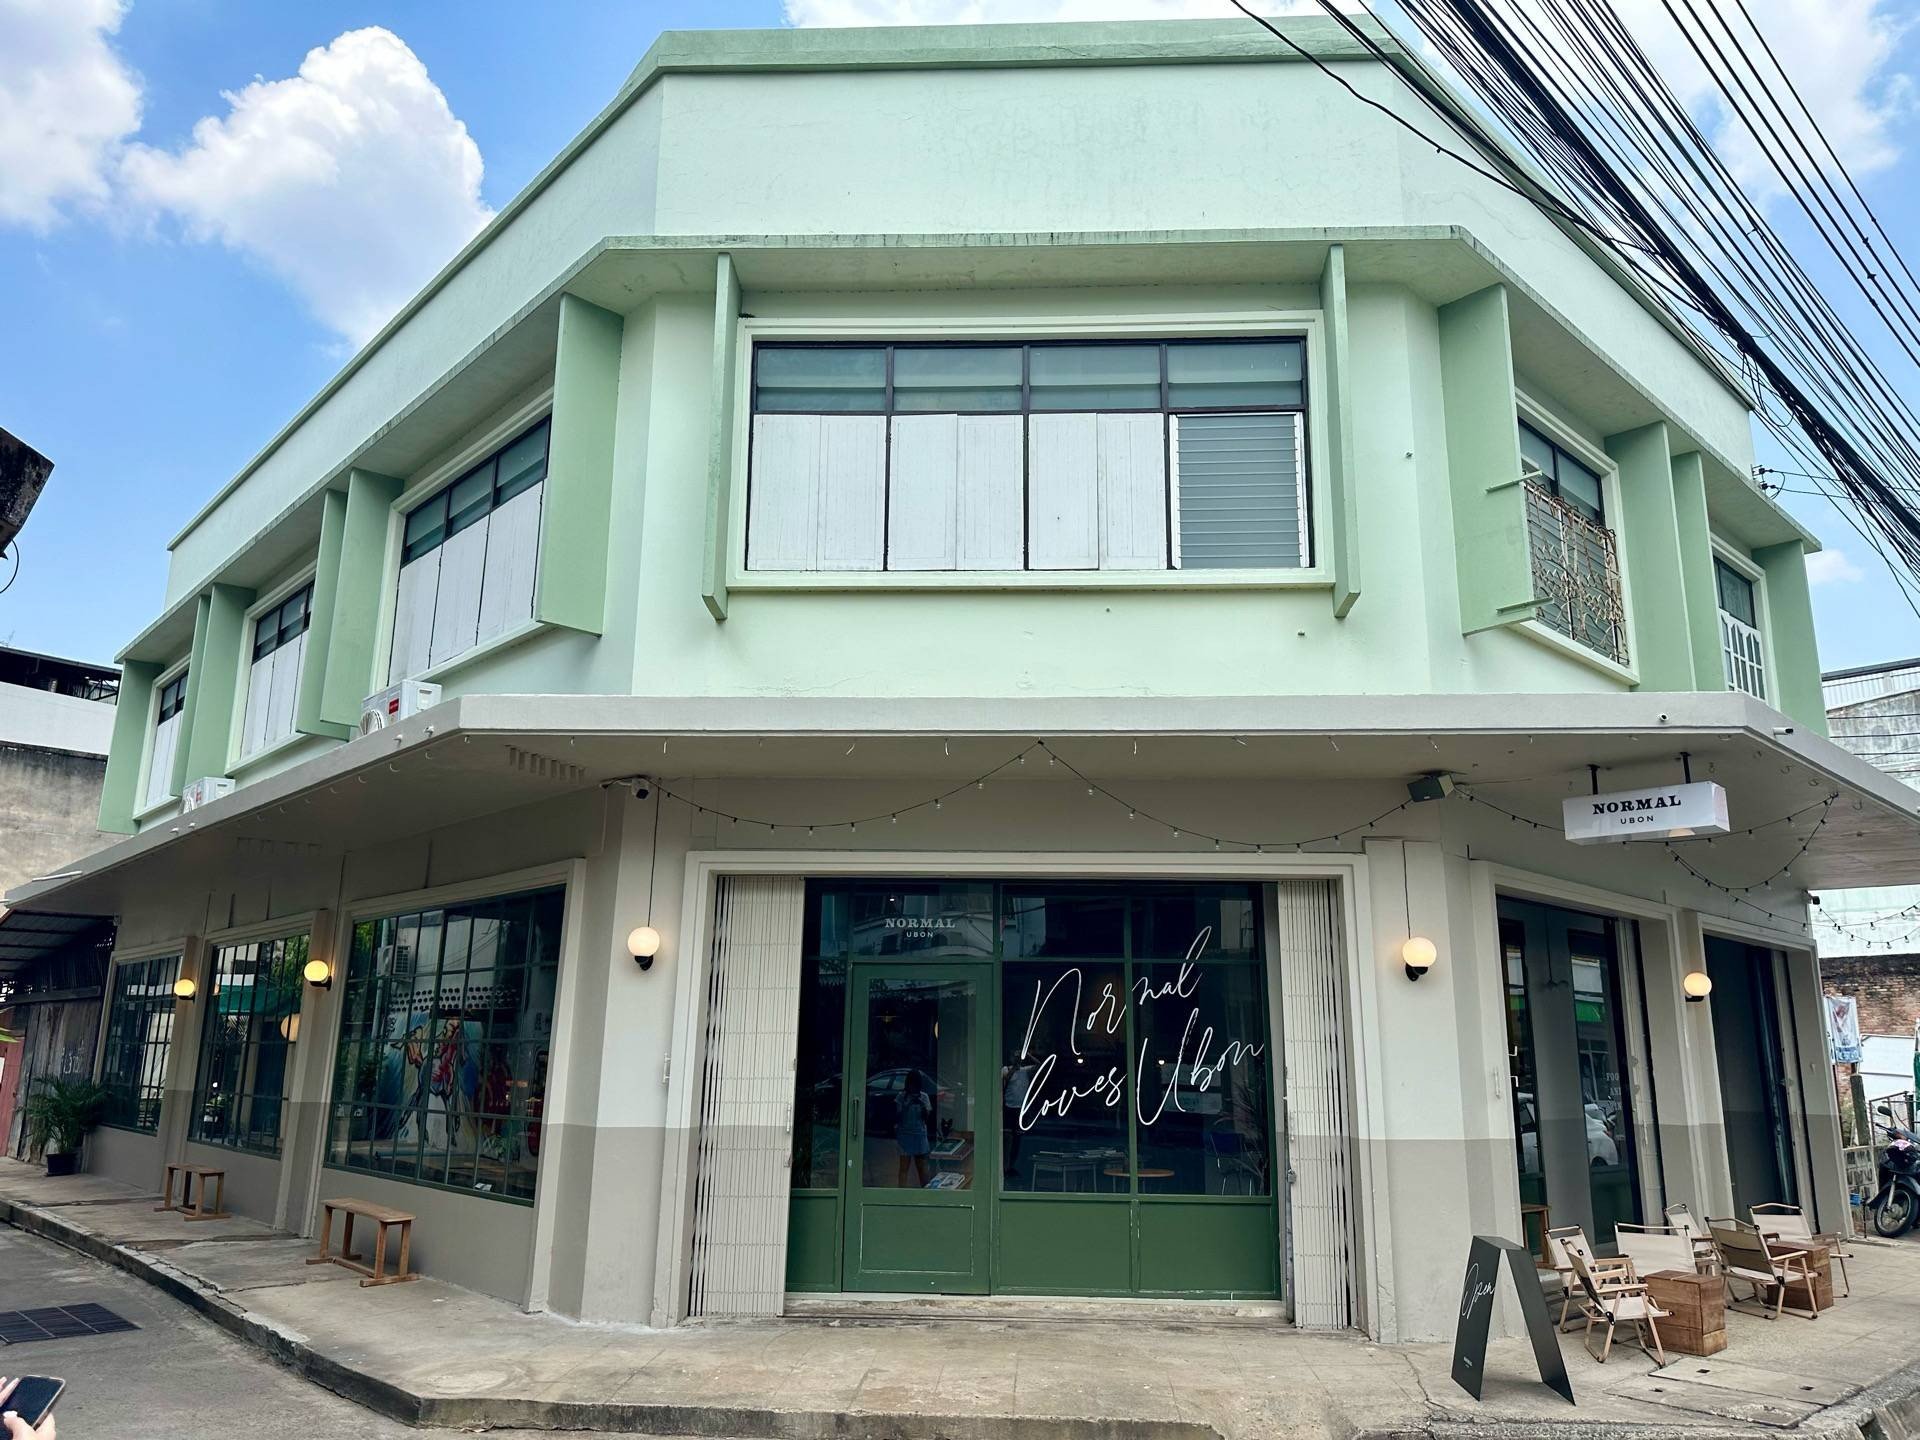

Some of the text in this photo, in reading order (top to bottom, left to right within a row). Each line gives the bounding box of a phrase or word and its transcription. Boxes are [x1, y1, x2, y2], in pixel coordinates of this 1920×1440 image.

[1593, 795, 1681, 815] NORMAL
[1620, 815, 1654, 825] UBON
[885, 918, 956, 929] NORMAL
[1020, 925, 1213, 1060] Normal
[1018, 1007, 1264, 1131] loves Ubon
[1461, 1262, 1496, 1320] Open
